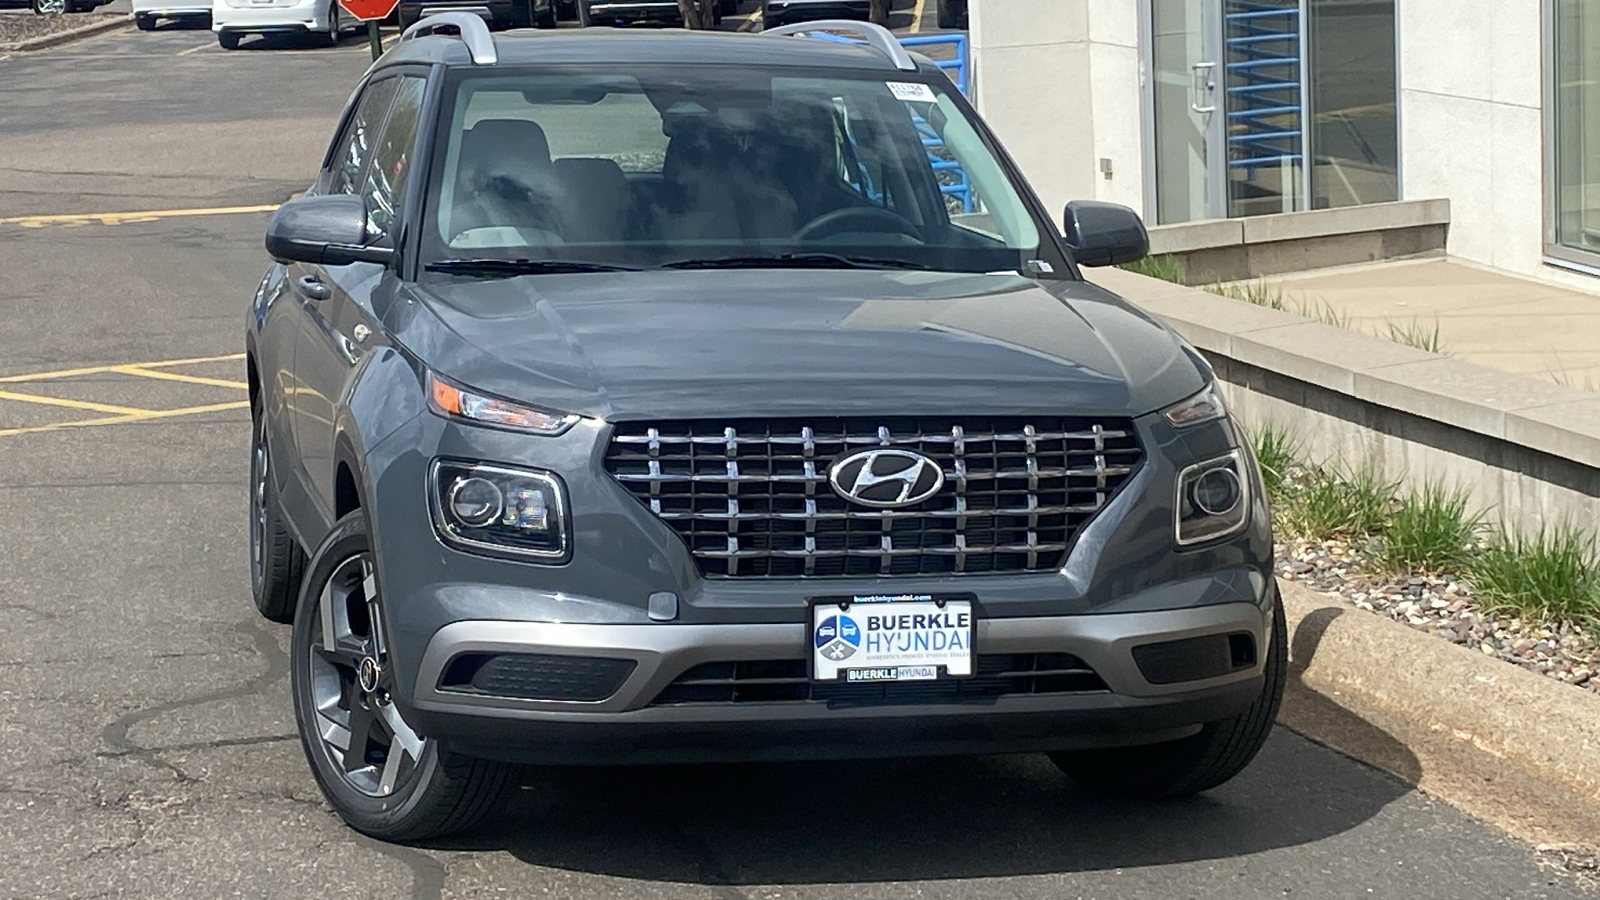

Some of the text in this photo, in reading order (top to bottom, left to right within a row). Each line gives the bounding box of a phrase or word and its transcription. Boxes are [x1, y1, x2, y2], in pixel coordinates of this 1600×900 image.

[868, 613, 969, 630] BUERKLE
[867, 631, 970, 652] HYUNDAI
[849, 667, 935, 680] BUERKLE HYUNDAI
